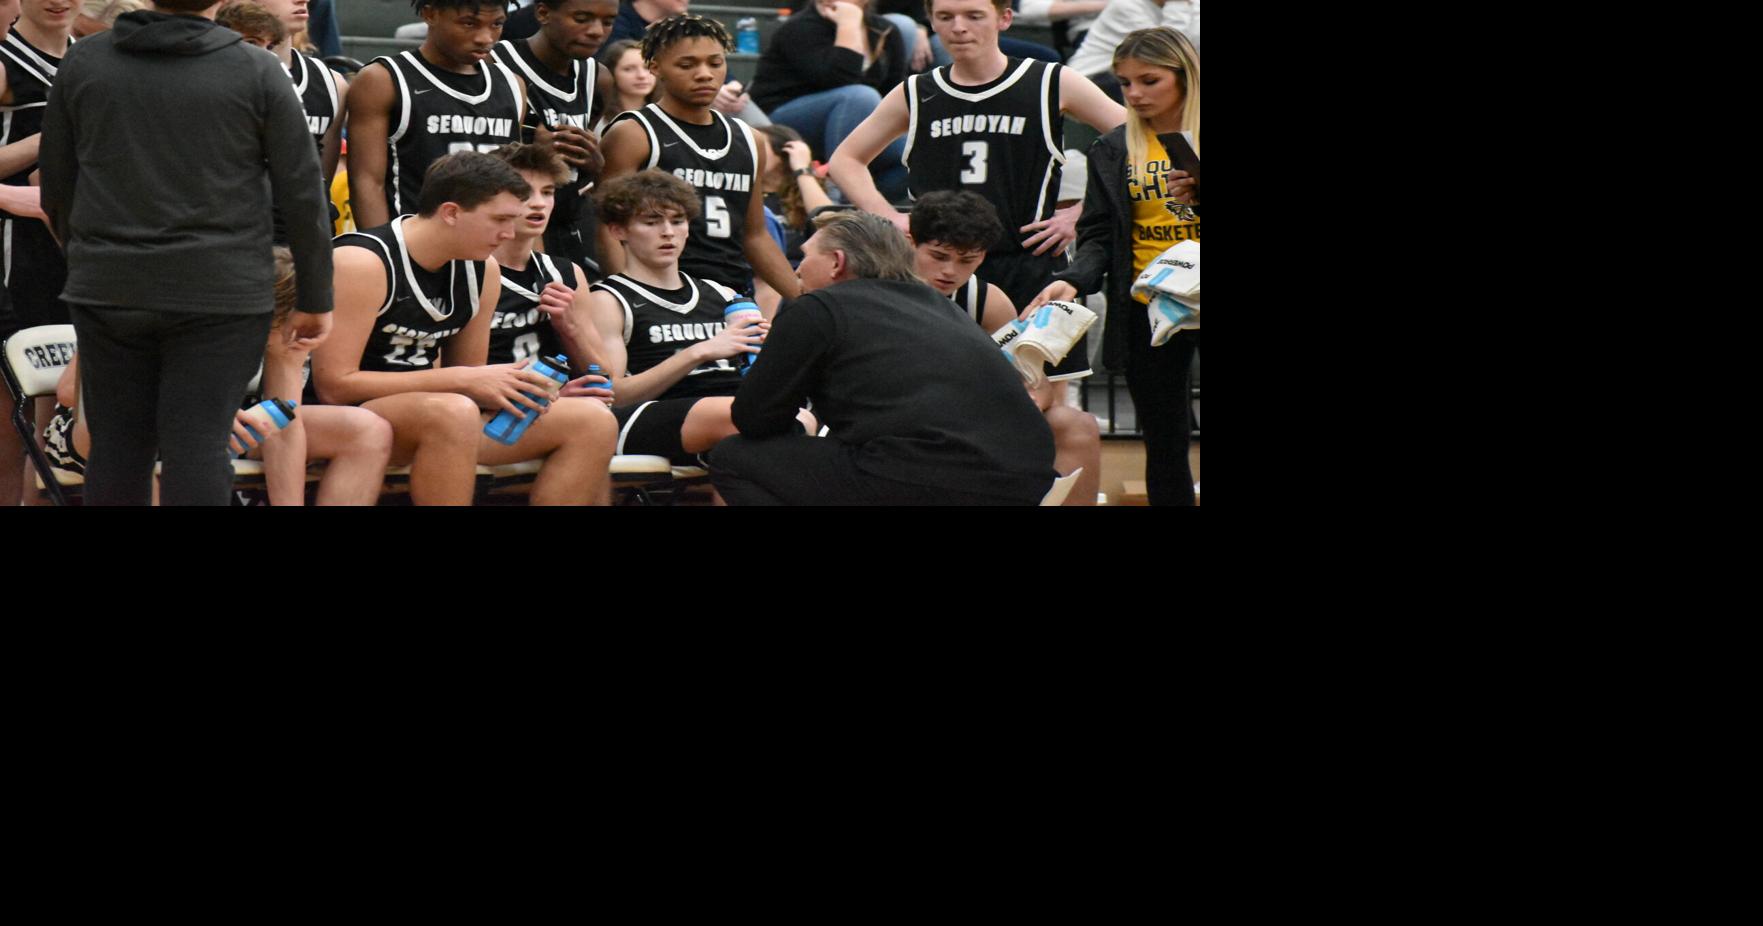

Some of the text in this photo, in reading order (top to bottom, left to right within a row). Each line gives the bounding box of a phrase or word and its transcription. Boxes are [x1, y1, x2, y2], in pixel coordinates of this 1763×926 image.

[427, 114, 513, 138] SEQUOYAH
[930, 114, 1027, 138] SEQUOYAH
[960, 140, 989, 184] 3
[673, 167, 752, 192] SEQUOYAH
[705, 195, 732, 238] 5
[648, 321, 728, 344] SEQUOYA
